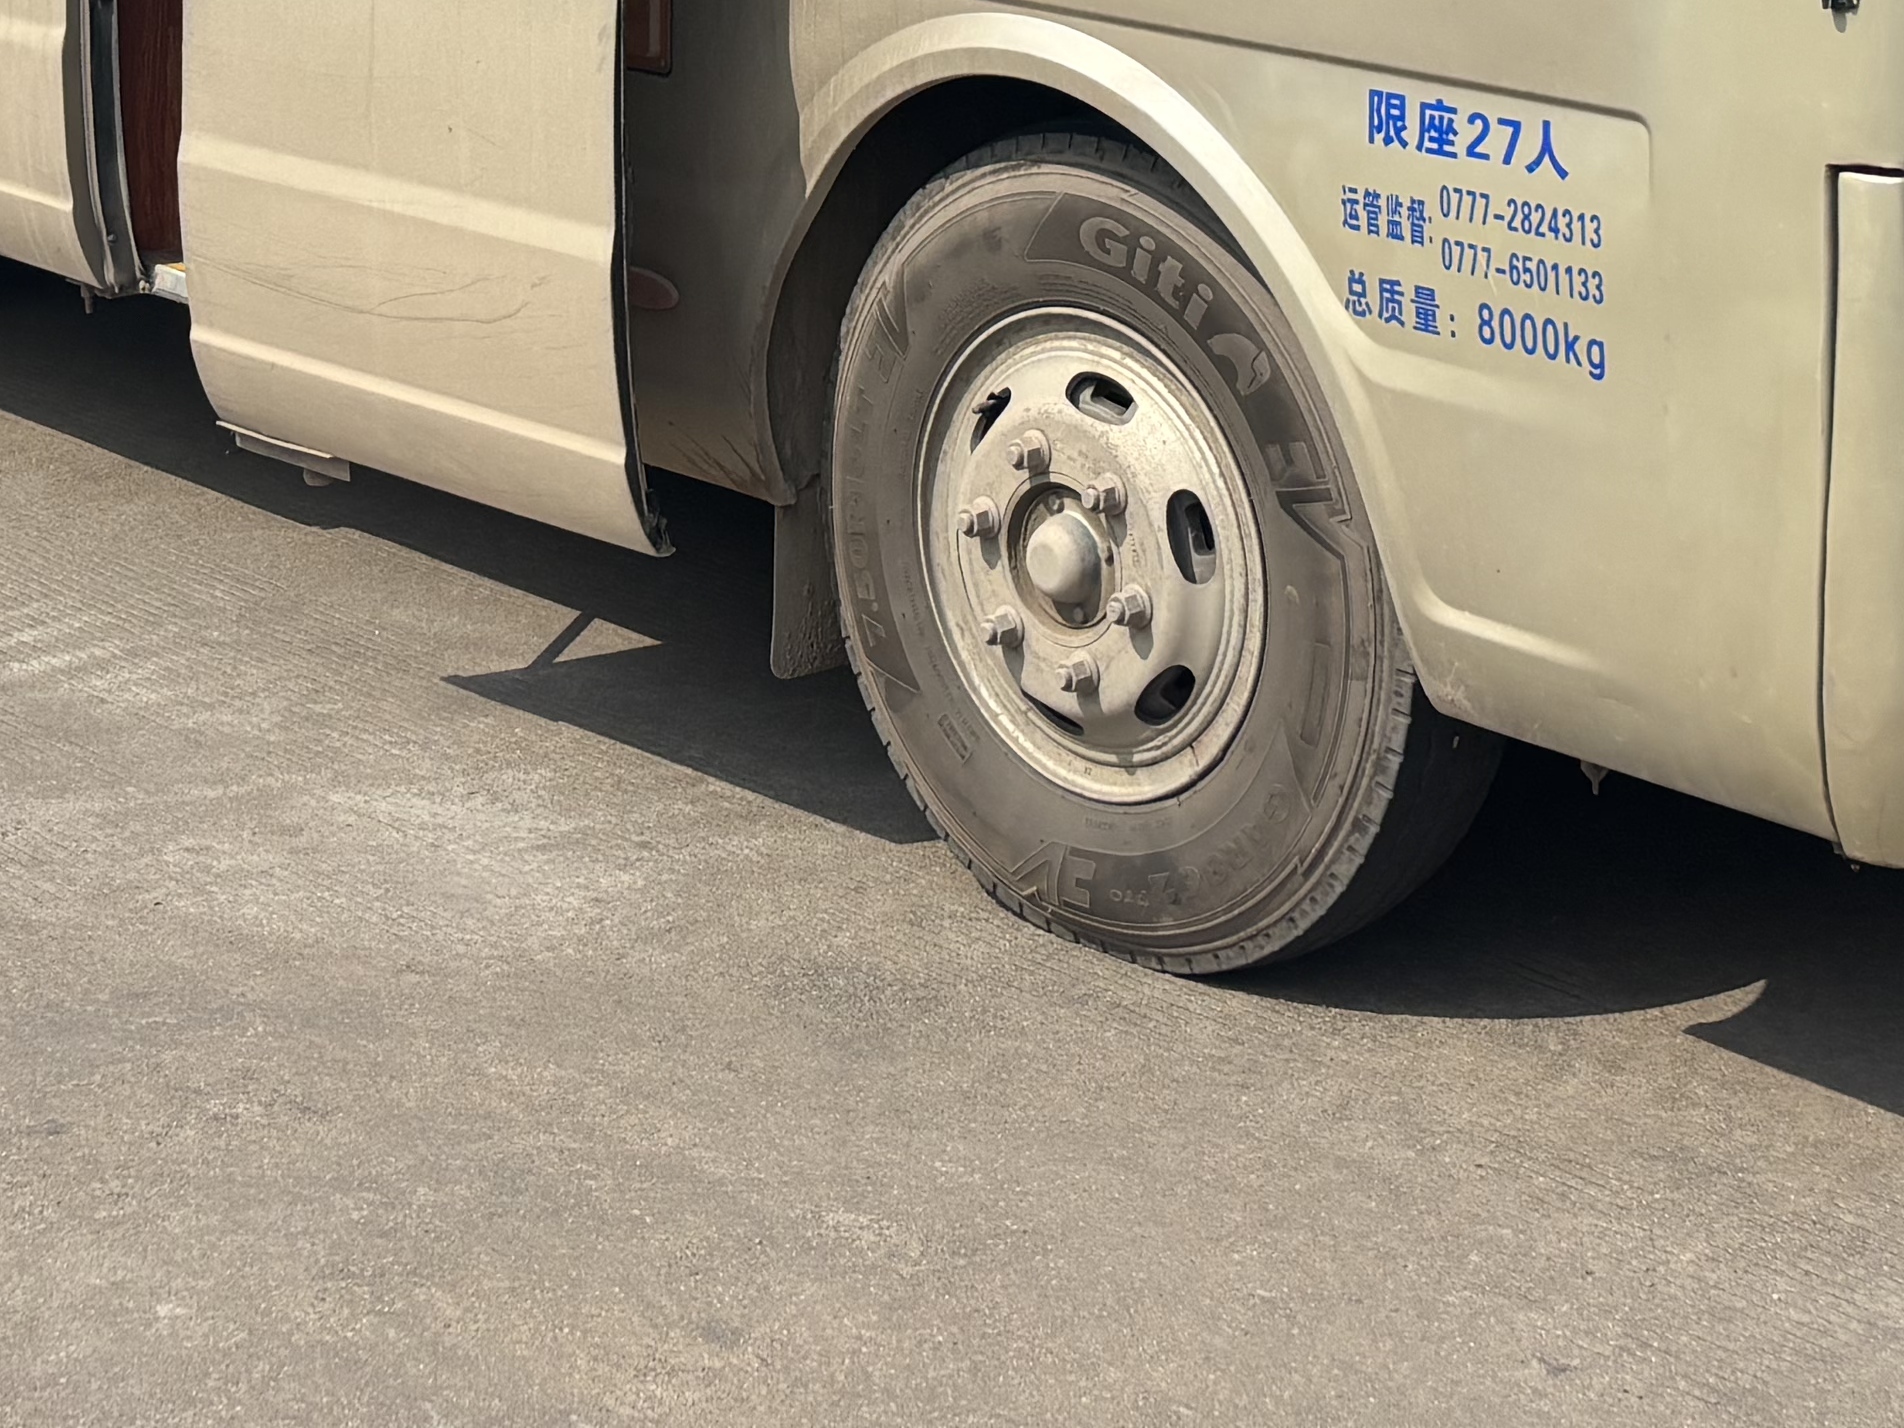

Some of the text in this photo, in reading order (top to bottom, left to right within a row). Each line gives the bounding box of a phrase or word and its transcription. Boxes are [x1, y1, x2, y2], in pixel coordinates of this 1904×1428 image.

[1367, 88, 1570, 181] 限座27人
[1439, 184, 1603, 249] 0777-2824313
[1079, 216, 1214, 331] Giti
[1441, 236, 1605, 305] 0777-6501133
